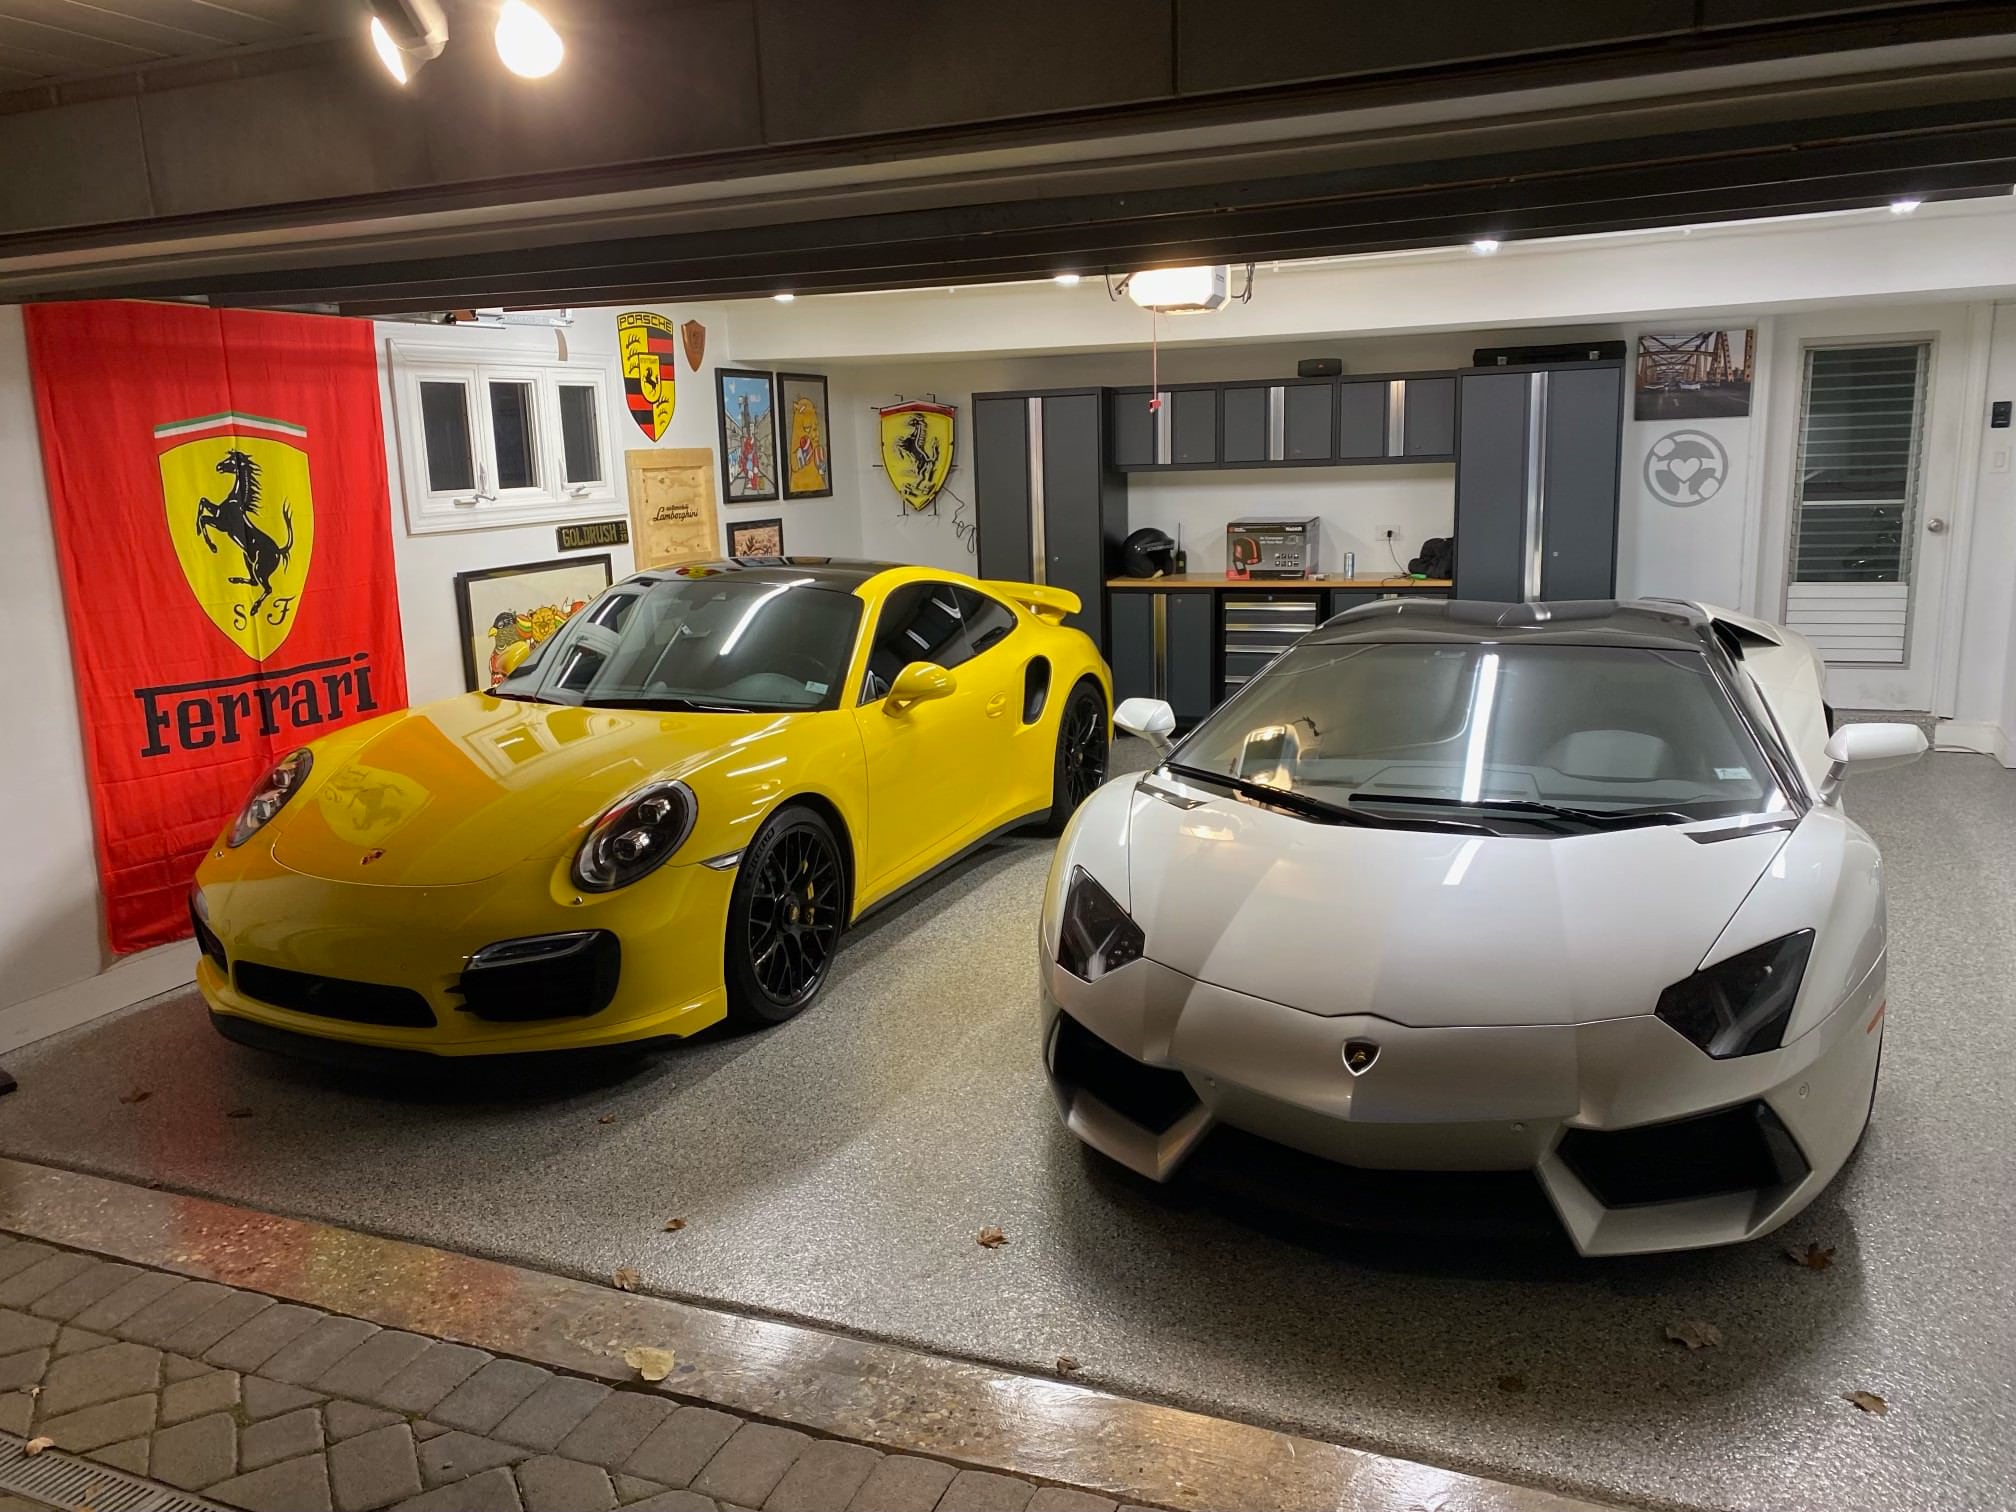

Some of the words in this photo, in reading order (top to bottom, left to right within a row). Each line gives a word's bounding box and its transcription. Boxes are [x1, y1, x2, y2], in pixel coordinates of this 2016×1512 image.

[619, 314, 672, 333] PORSCHE
[653, 506, 699, 522] Lamborghini
[562, 523, 617, 547] GOLDRUSH
[233, 604, 248, 631] S
[134, 652, 378, 757] Ferrari
